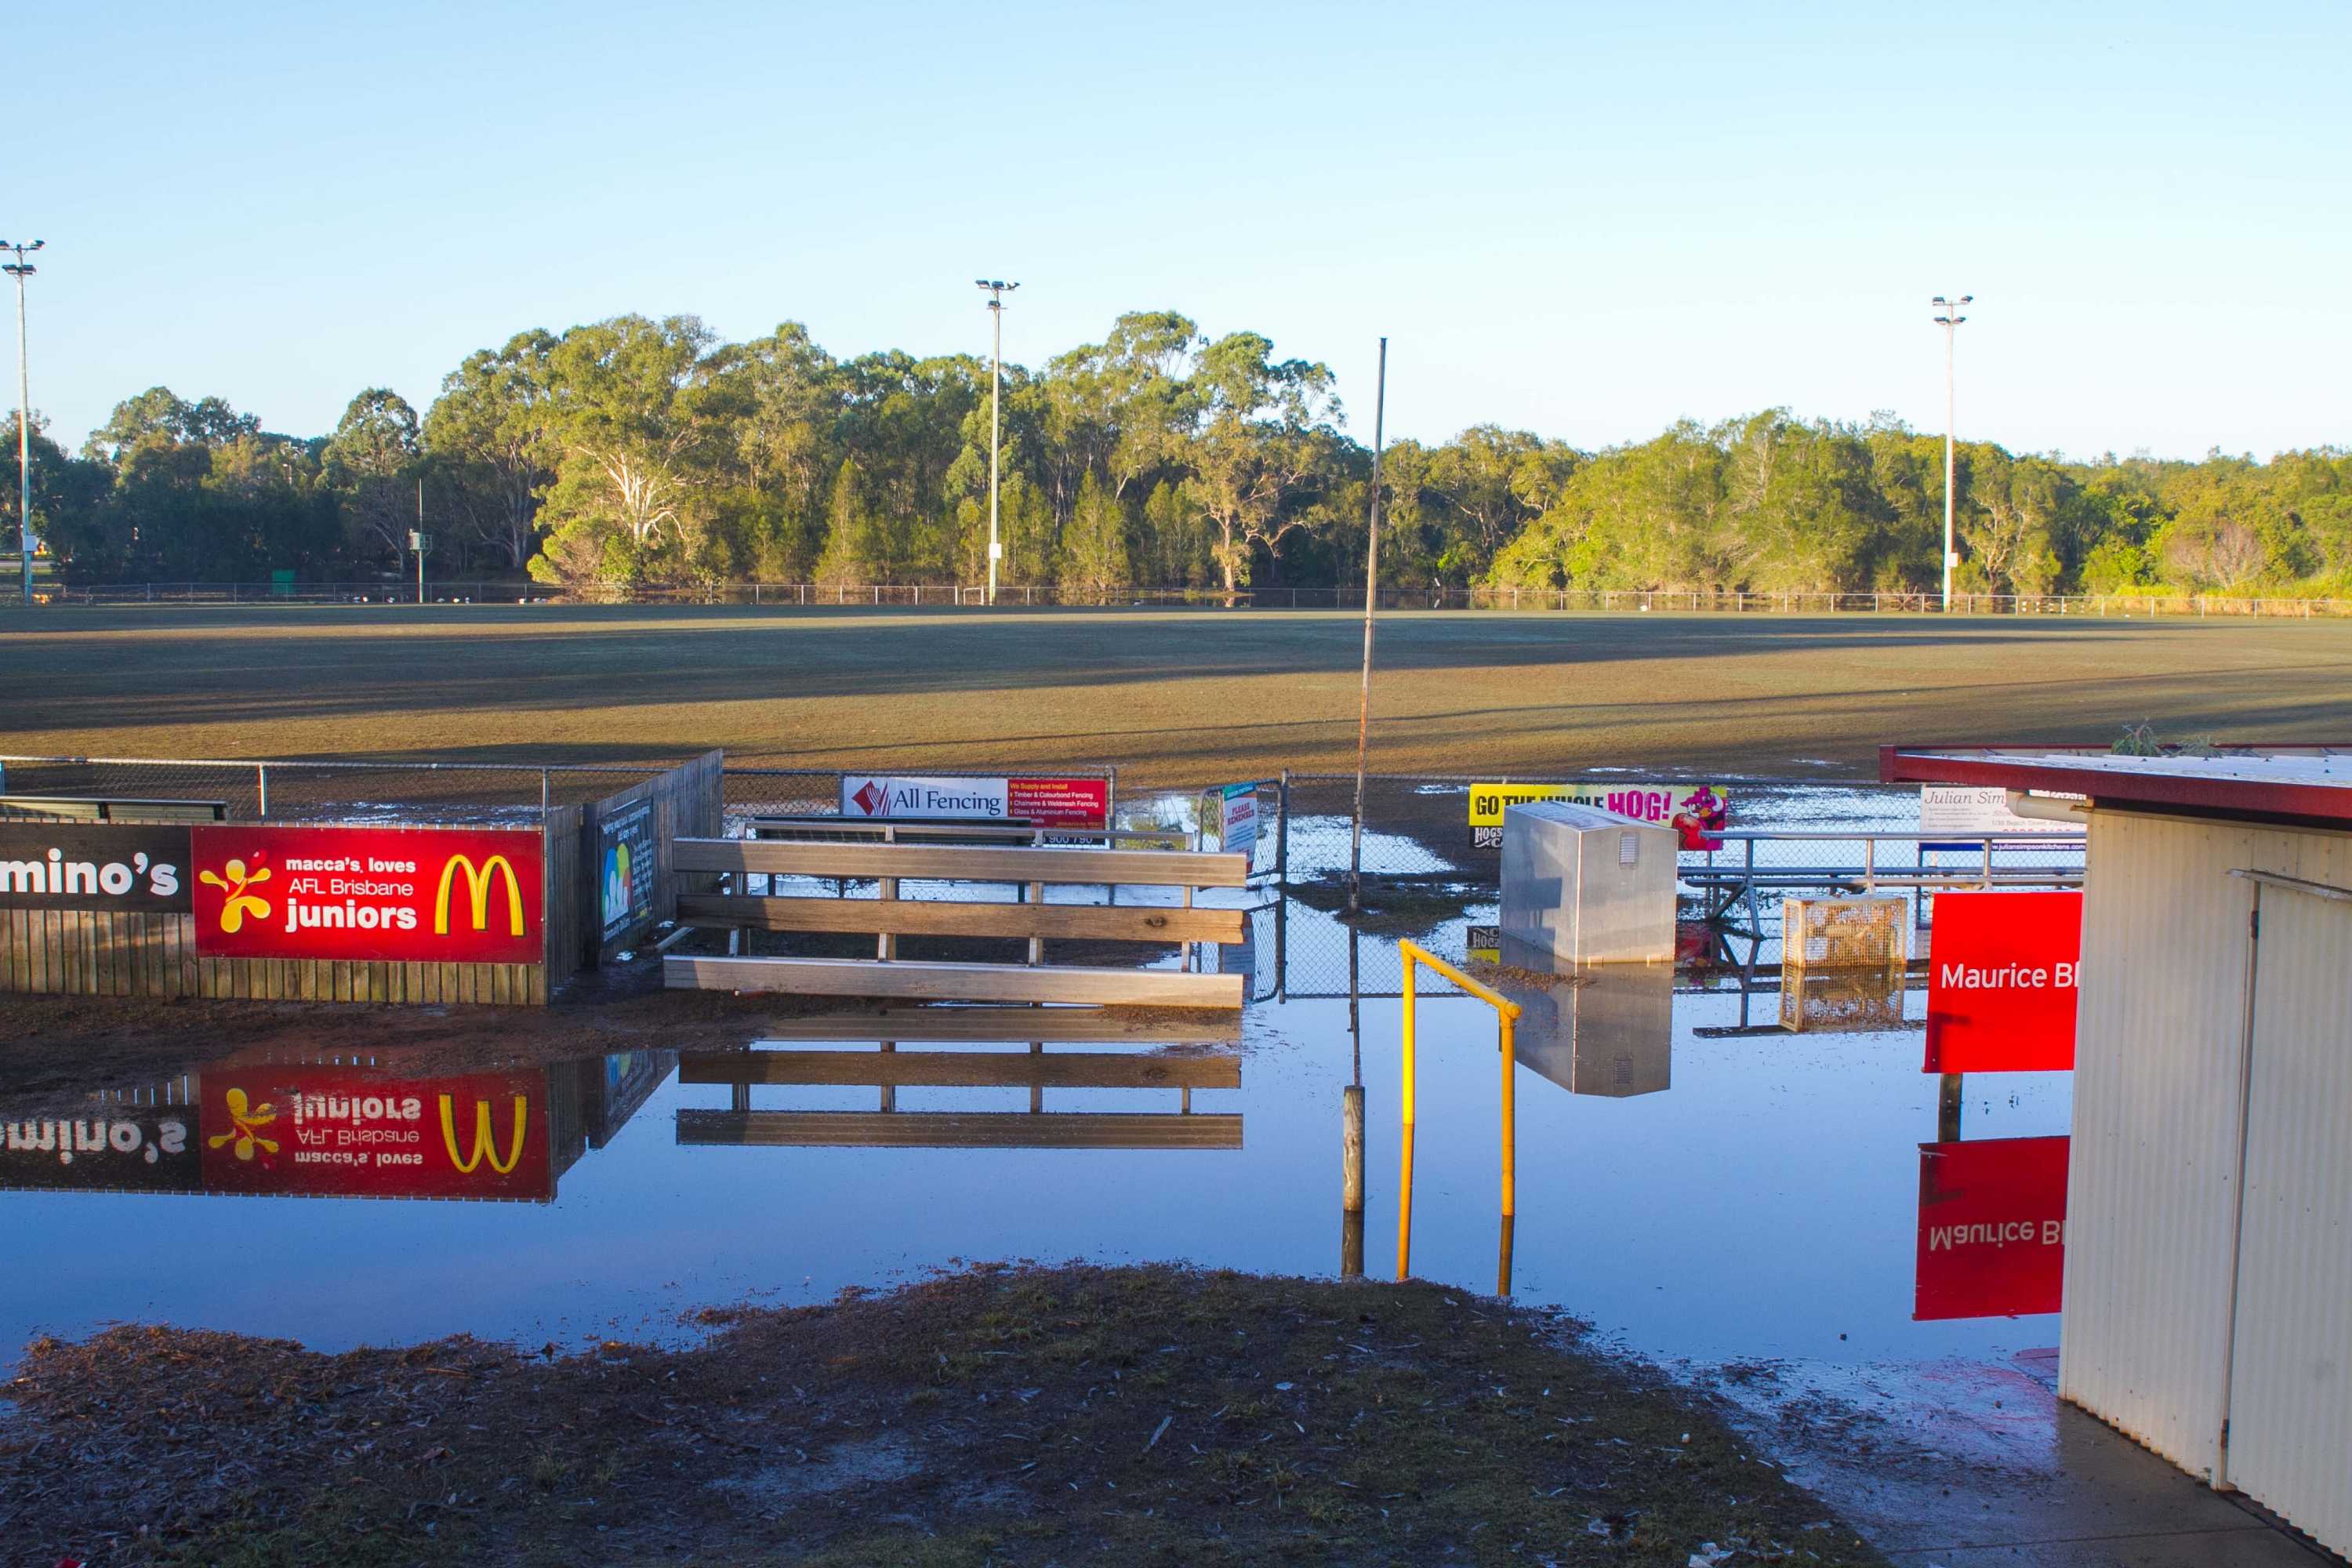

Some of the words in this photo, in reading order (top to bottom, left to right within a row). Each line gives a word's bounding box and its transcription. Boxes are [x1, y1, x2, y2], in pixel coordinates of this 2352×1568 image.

[894, 788, 919, 808] All
[927, 790, 1002, 816] Fencing
[1476, 796, 1499, 815] GO
[1607, 789, 1671, 822] HOG!
[1925, 791, 1972, 804] Julian
[1232, 802, 1250, 815] PLEASE
[368, 857, 416, 873] loves
[289, 878, 326, 895] AFL
[330, 878, 414, 896] Brisbane
[285, 898, 417, 933] juniors
[1940, 962, 2047, 989] Maurice
